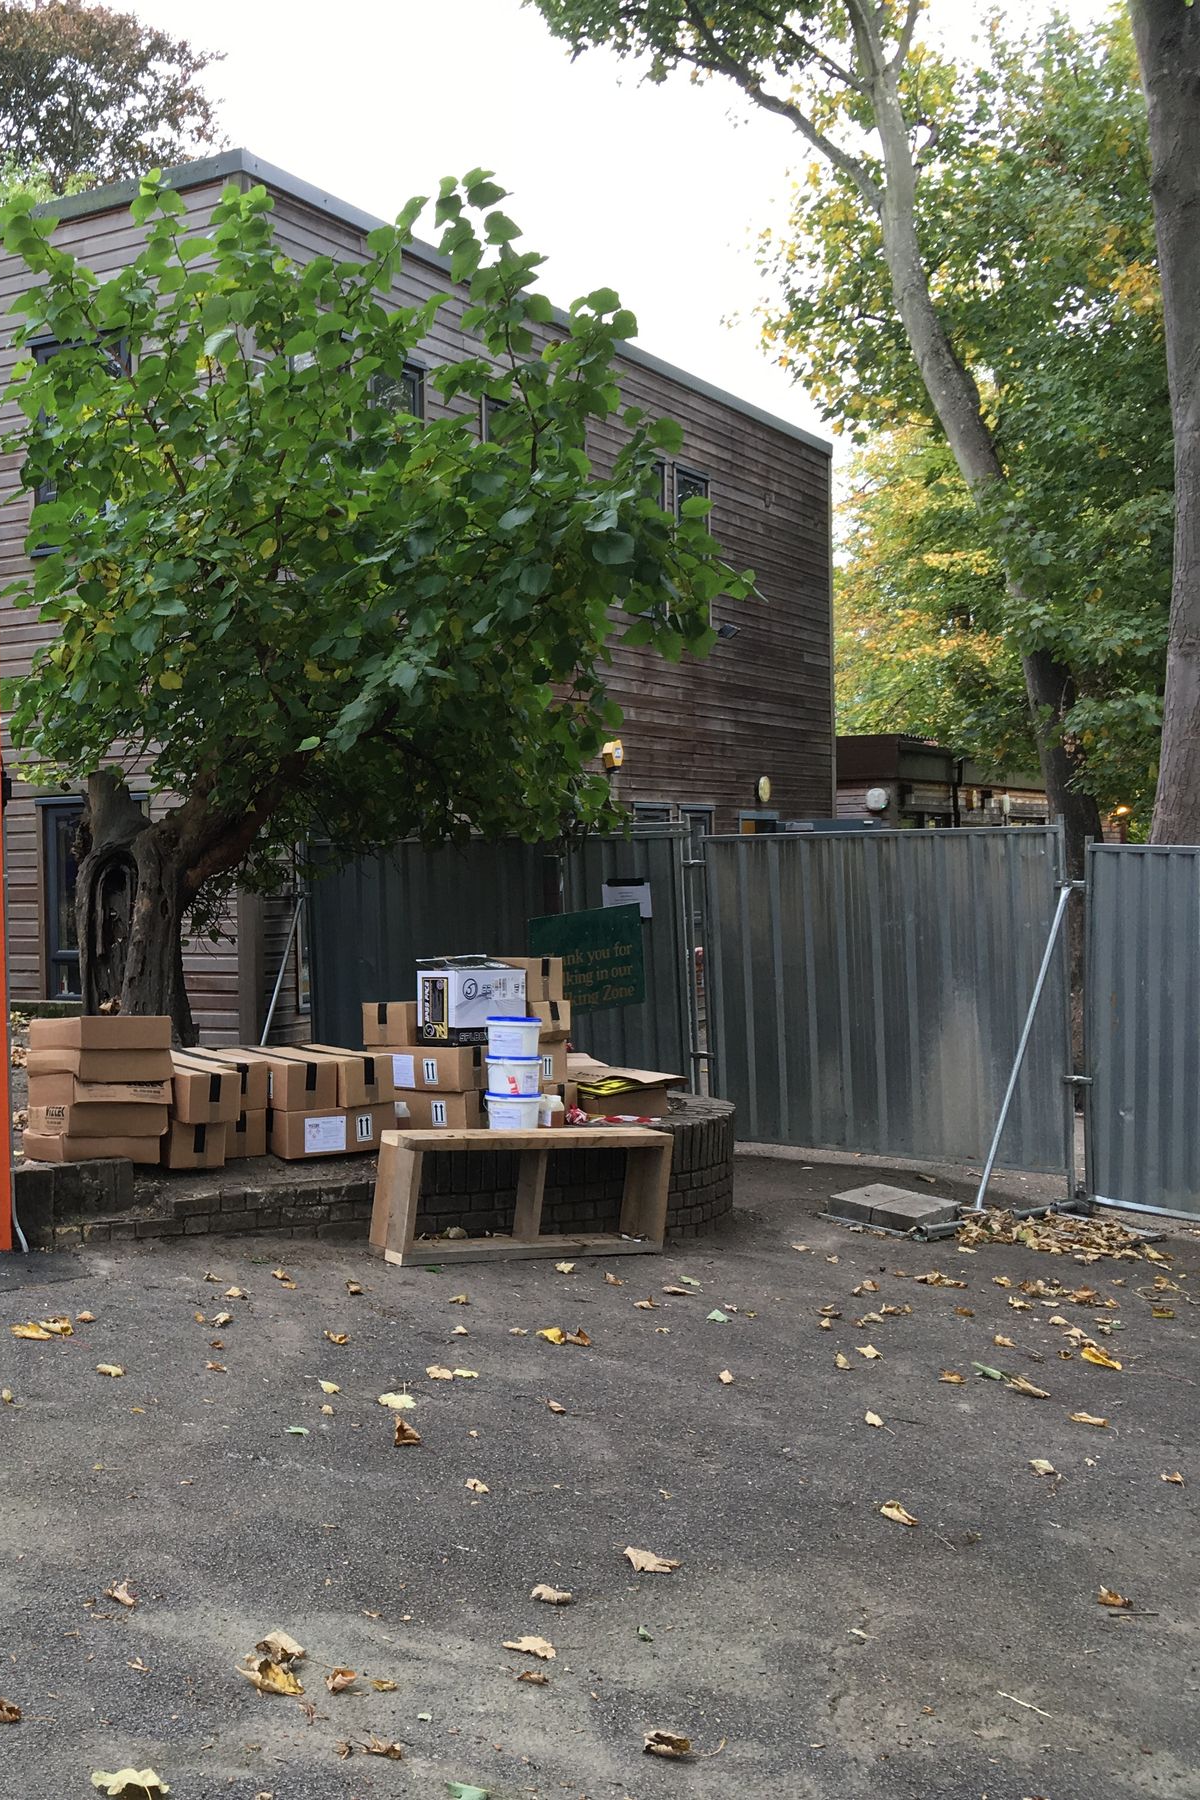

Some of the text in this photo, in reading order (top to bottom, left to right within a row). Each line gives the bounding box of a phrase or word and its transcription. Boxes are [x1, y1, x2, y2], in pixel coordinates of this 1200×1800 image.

[587, 948, 610, 966] you
[613, 941, 633, 957] for
[596, 966, 609, 981] in
[611, 965, 633, 978] our
[602, 984, 635, 1001] Zone
